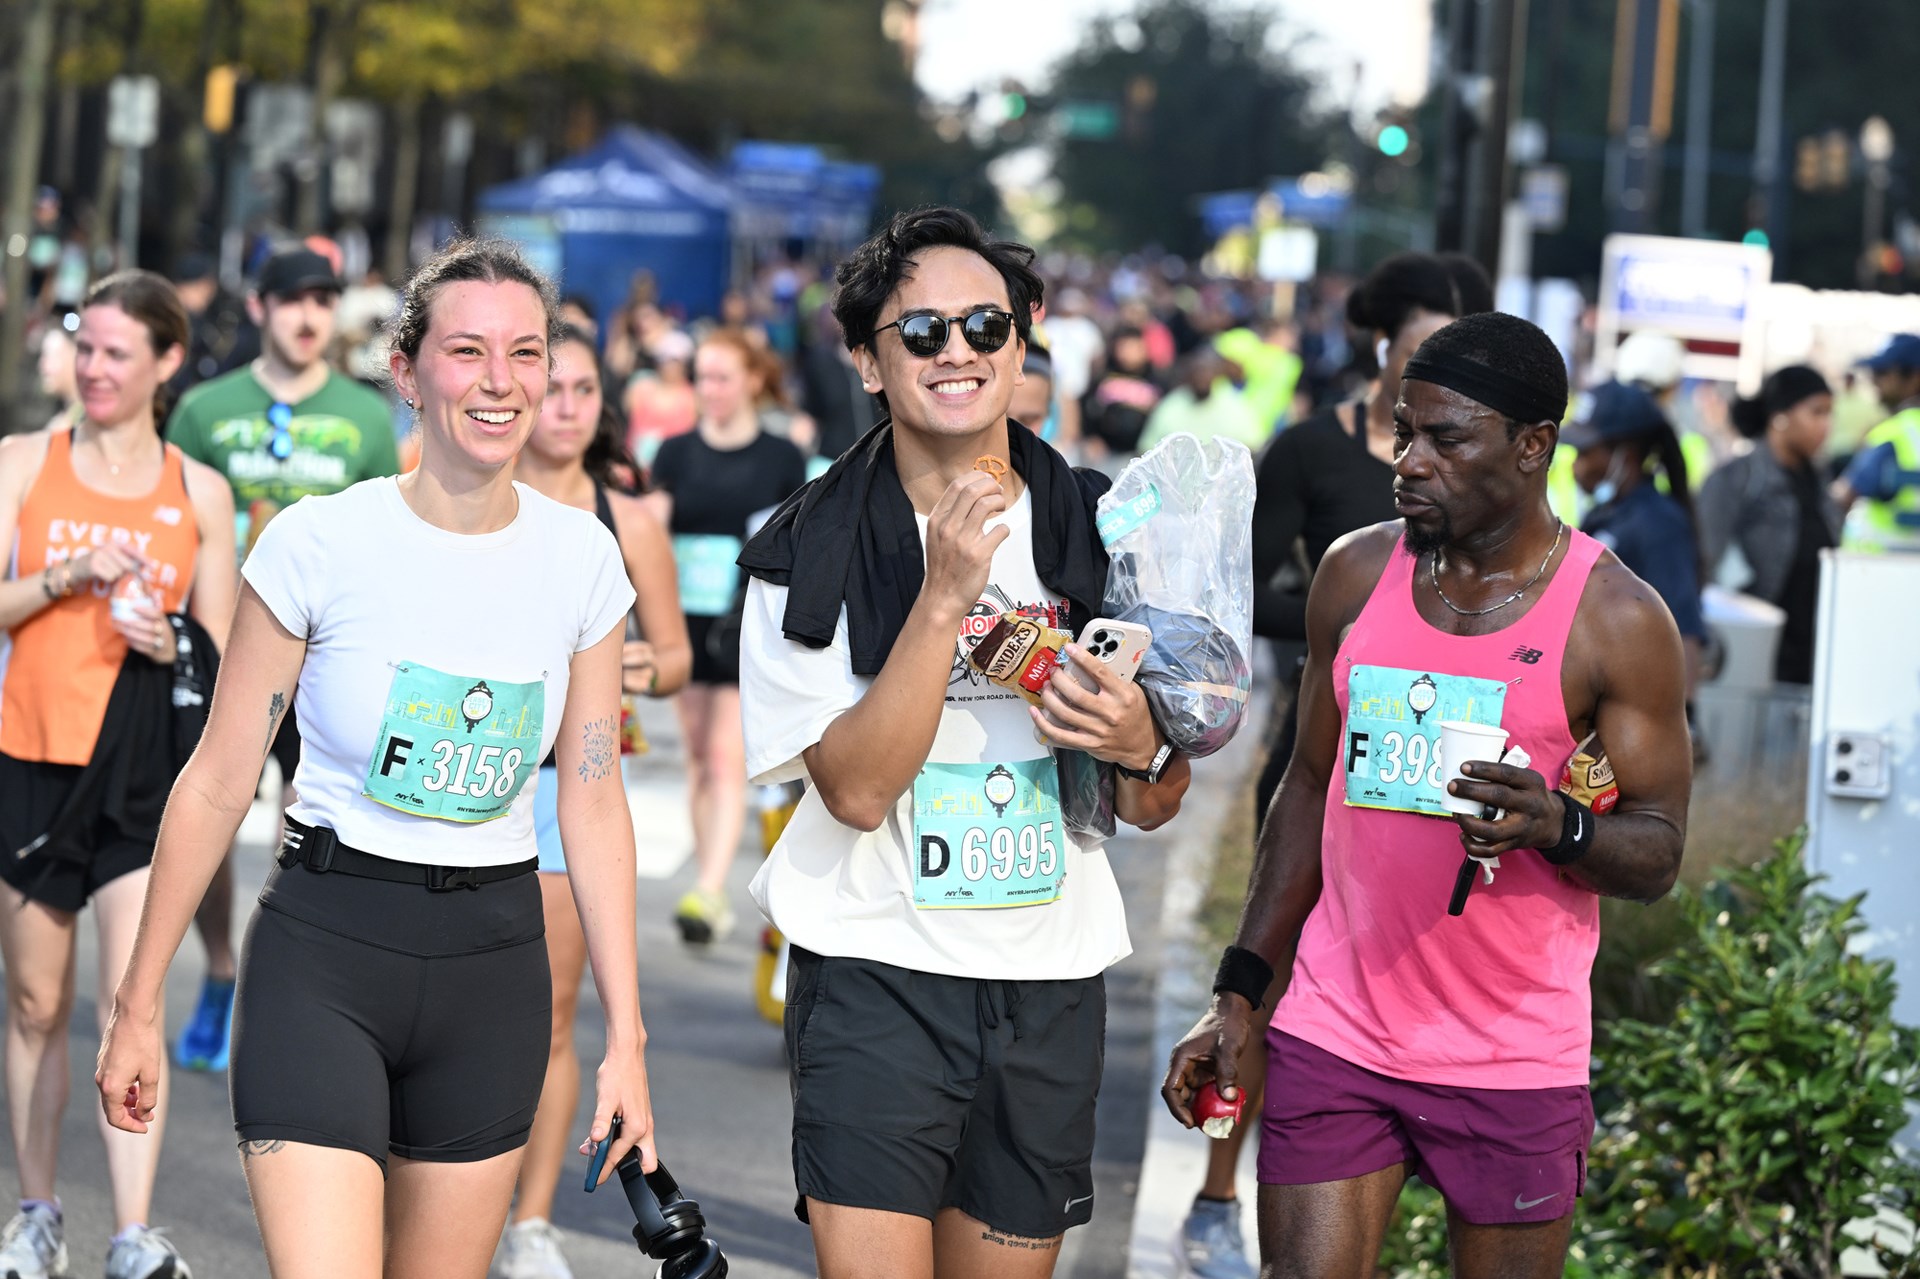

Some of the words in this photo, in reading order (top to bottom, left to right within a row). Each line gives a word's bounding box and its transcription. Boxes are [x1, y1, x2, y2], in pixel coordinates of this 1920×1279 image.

[1132, 492, 1157, 518] 699
[48, 518, 152, 554] EVERY
[990, 627, 1032, 674] SNYDER'S
[468, 702, 487, 712] CITY
[380, 735, 414, 777] F
[422, 739, 523, 799] 3158
[1348, 731, 1369, 773] F
[1379, 731, 1442, 789] 398
[920, 835, 950, 878] D
[961, 821, 1057, 882] 6995
